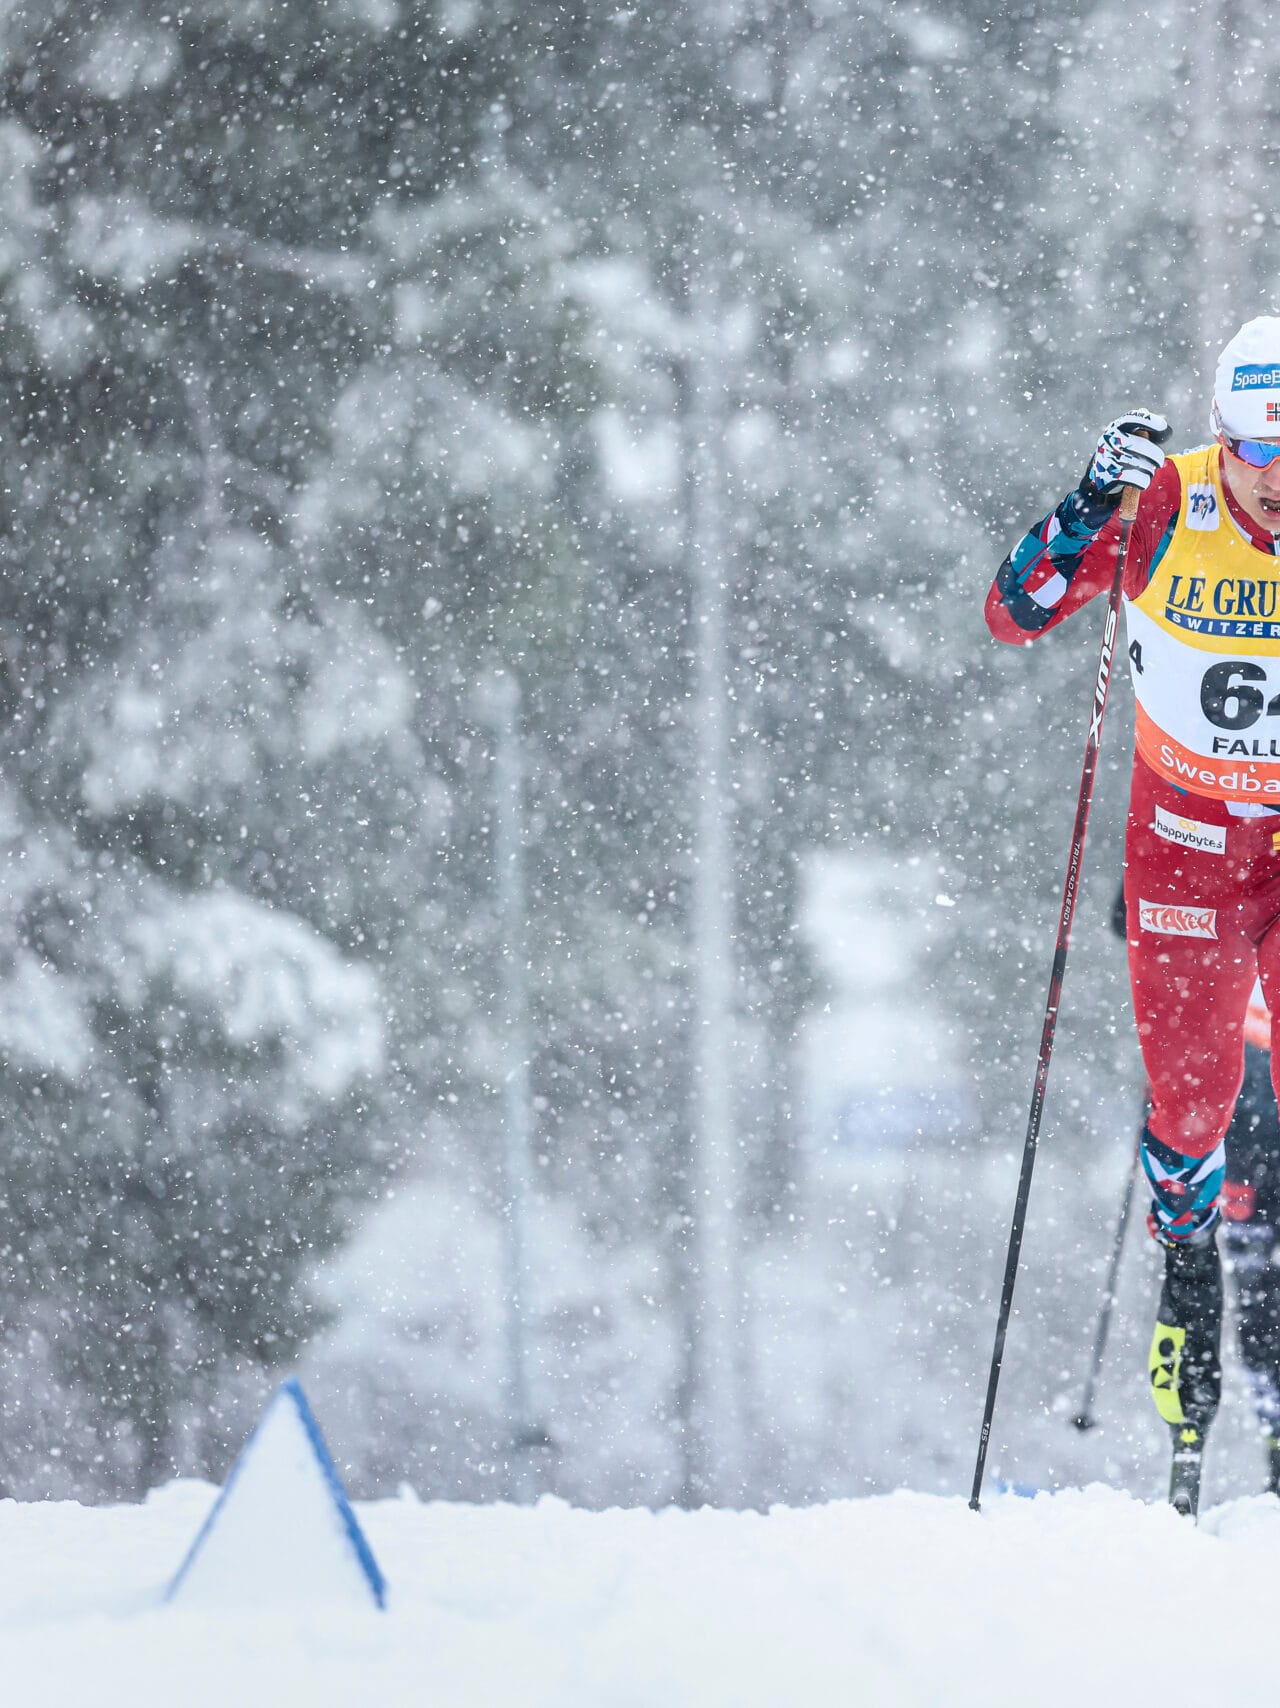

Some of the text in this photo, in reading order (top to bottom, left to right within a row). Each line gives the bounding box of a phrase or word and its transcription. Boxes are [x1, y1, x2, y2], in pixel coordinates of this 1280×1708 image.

[1166, 575, 1206, 612] LE
[1089, 605, 1117, 750] SWIX
[1157, 820, 1223, 849] happybytes
